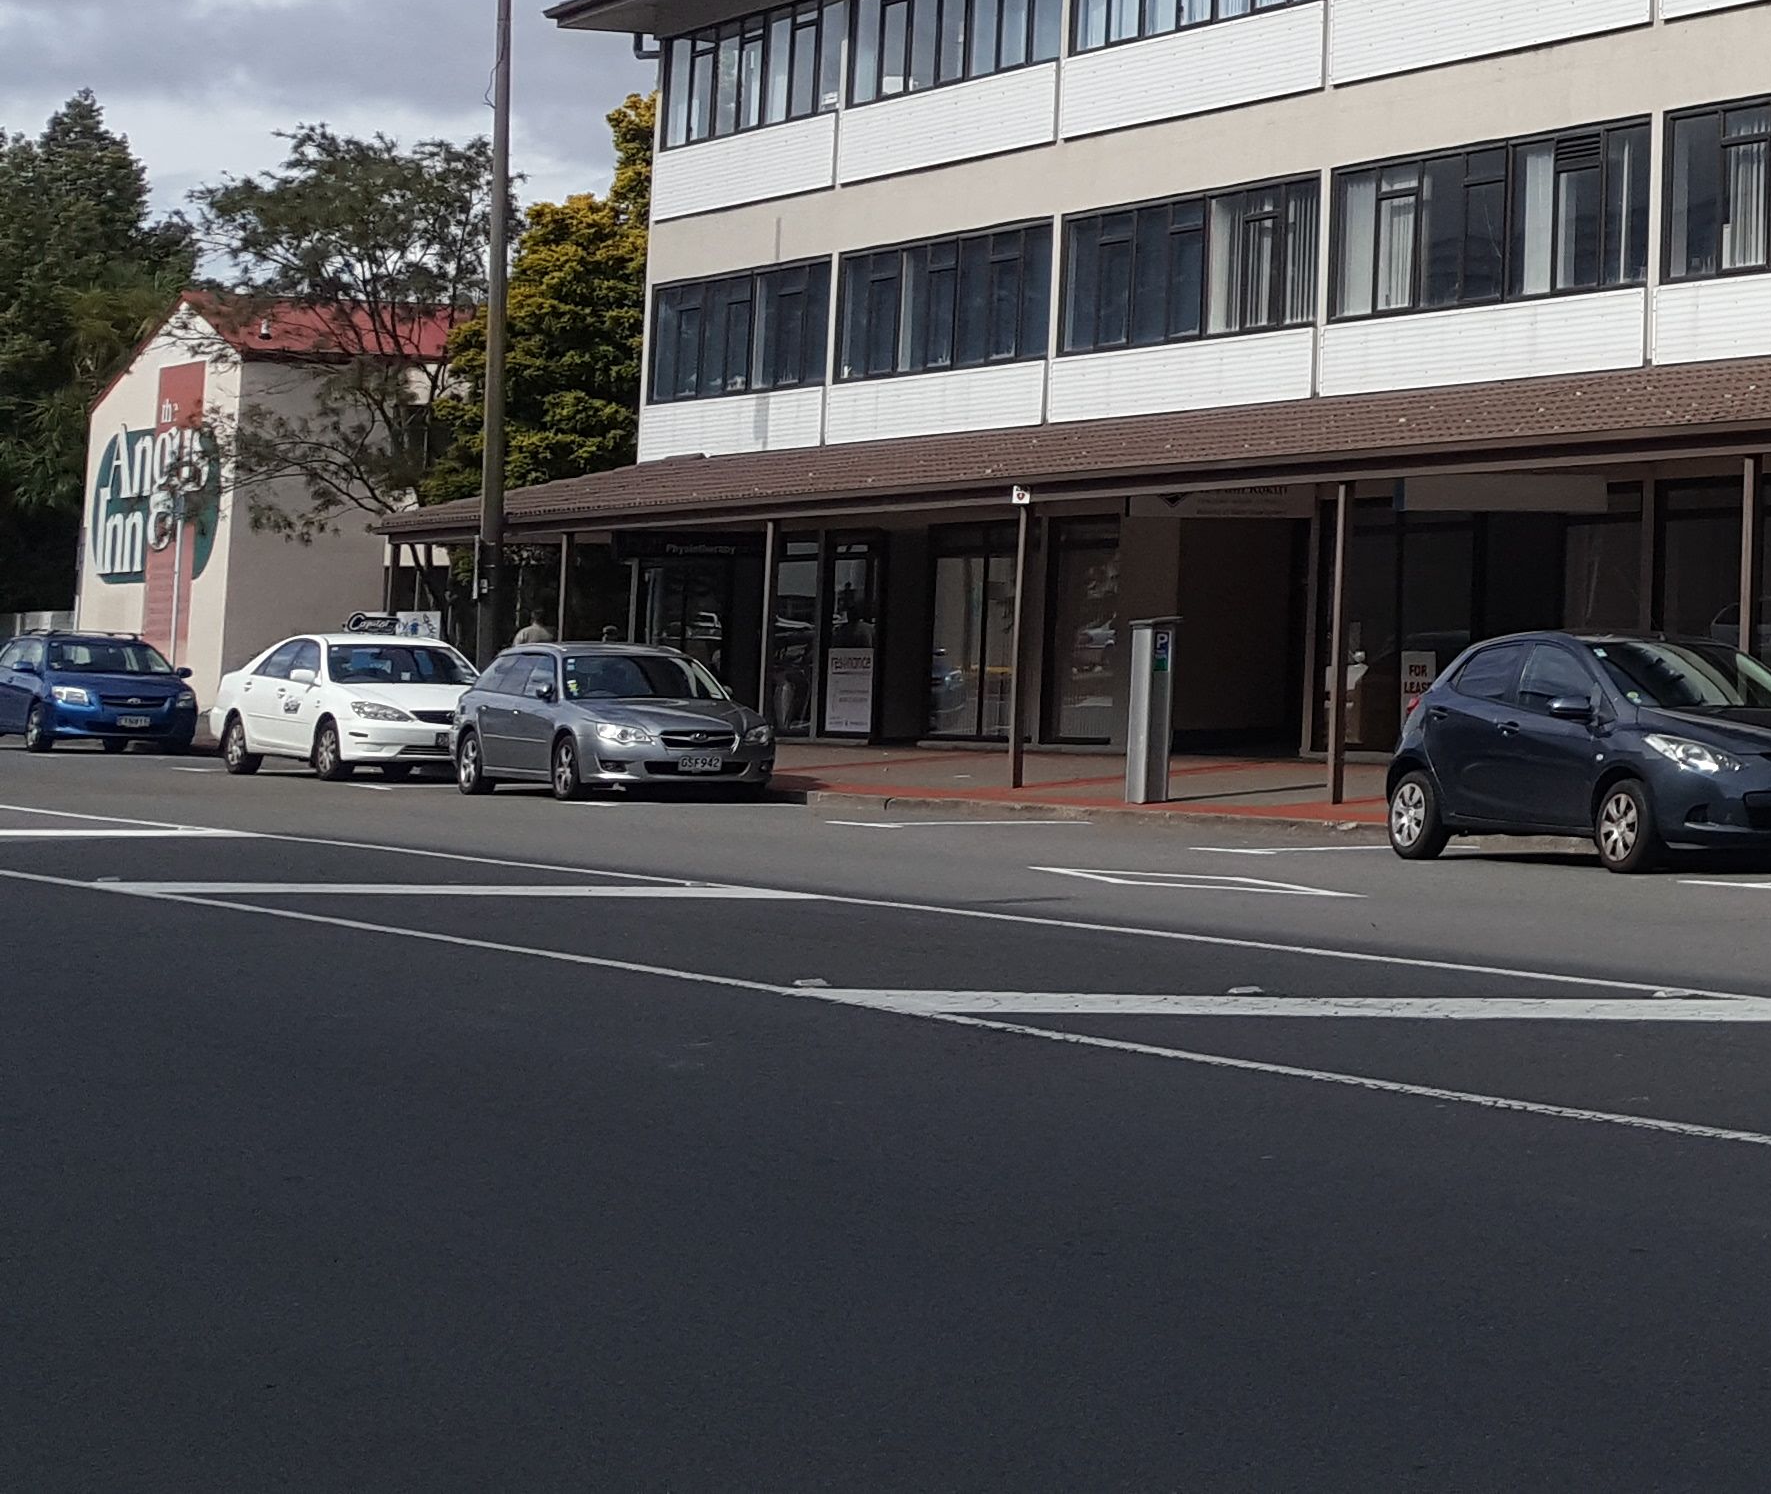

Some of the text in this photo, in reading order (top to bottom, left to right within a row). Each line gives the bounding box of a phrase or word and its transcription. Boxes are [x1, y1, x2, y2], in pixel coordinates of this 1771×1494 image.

[97, 487, 144, 574] Inn
[1157, 633, 1168, 648] P
[1408, 665, 1428, 677] FOR
